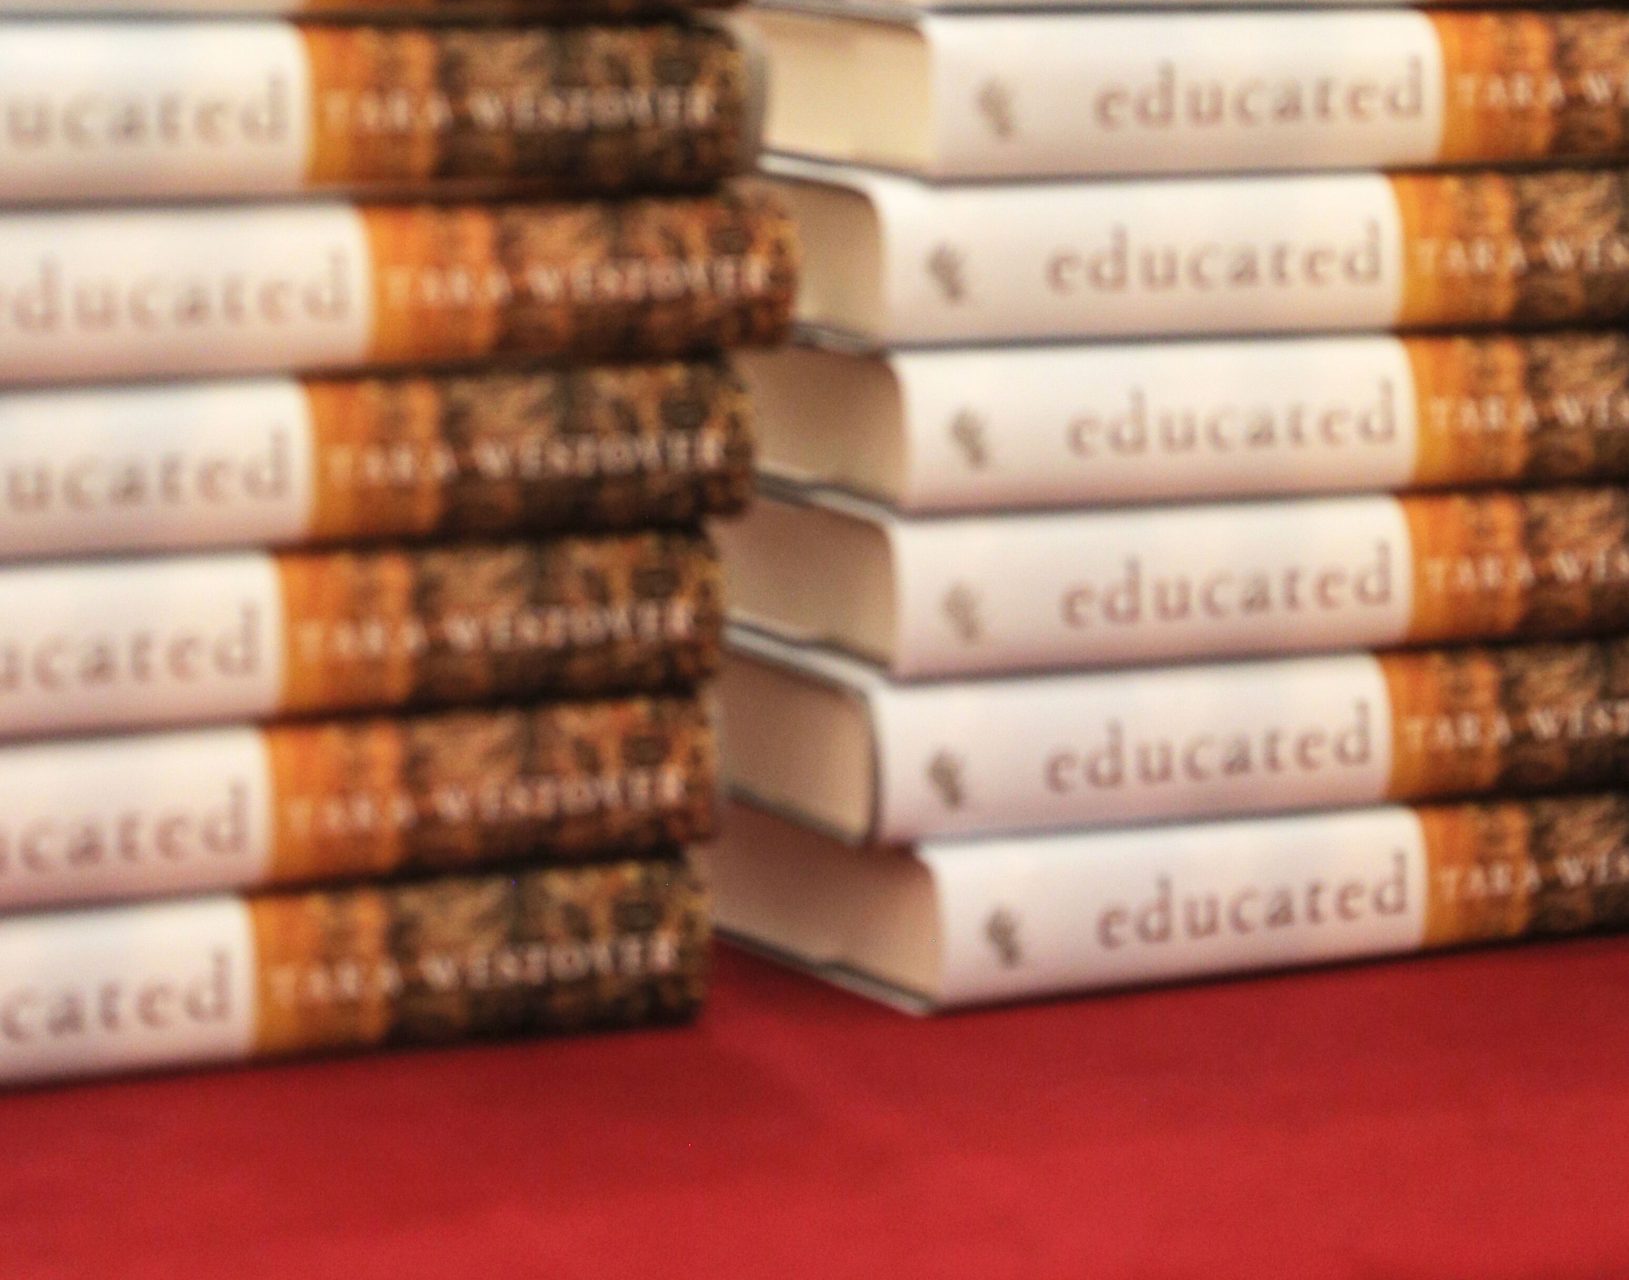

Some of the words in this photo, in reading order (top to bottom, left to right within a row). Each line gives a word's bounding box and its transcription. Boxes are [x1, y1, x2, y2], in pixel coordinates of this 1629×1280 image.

[8, 71, 288, 148] ucated
[324, 89, 452, 134] TARA
[468, 83, 718, 134] WESTOVER
[1093, 54, 1423, 136] educated
[1457, 72, 1566, 111] TARA
[0, 247, 349, 334] ducated
[385, 263, 512, 310] TARA
[526, 255, 770, 304] WESTOVER
[1045, 220, 1382, 293] educated
[1417, 235, 1528, 275] TARA
[1067, 376, 1396, 458] educated
[1430, 395, 1539, 436] TARA
[6, 422, 290, 512] ucated
[328, 440, 456, 490] TARA
[472, 429, 728, 480] WESTOVER
[1060, 540, 1393, 627] educated
[1427, 552, 1536, 592] TARA
[298, 618, 428, 662] TARA
[444, 597, 692, 654] WESTOVER
[1045, 703, 1371, 794] educated
[1406, 711, 1514, 752] TARA
[0, 780, 249, 872] cated
[290, 792, 418, 838] TARA
[434, 766, 686, 824] WESTOVER
[1099, 852, 1408, 949] educated
[1441, 857, 1543, 904] TARA
[268, 956, 400, 1012] TARA
[418, 928, 678, 992] WESTOVER
